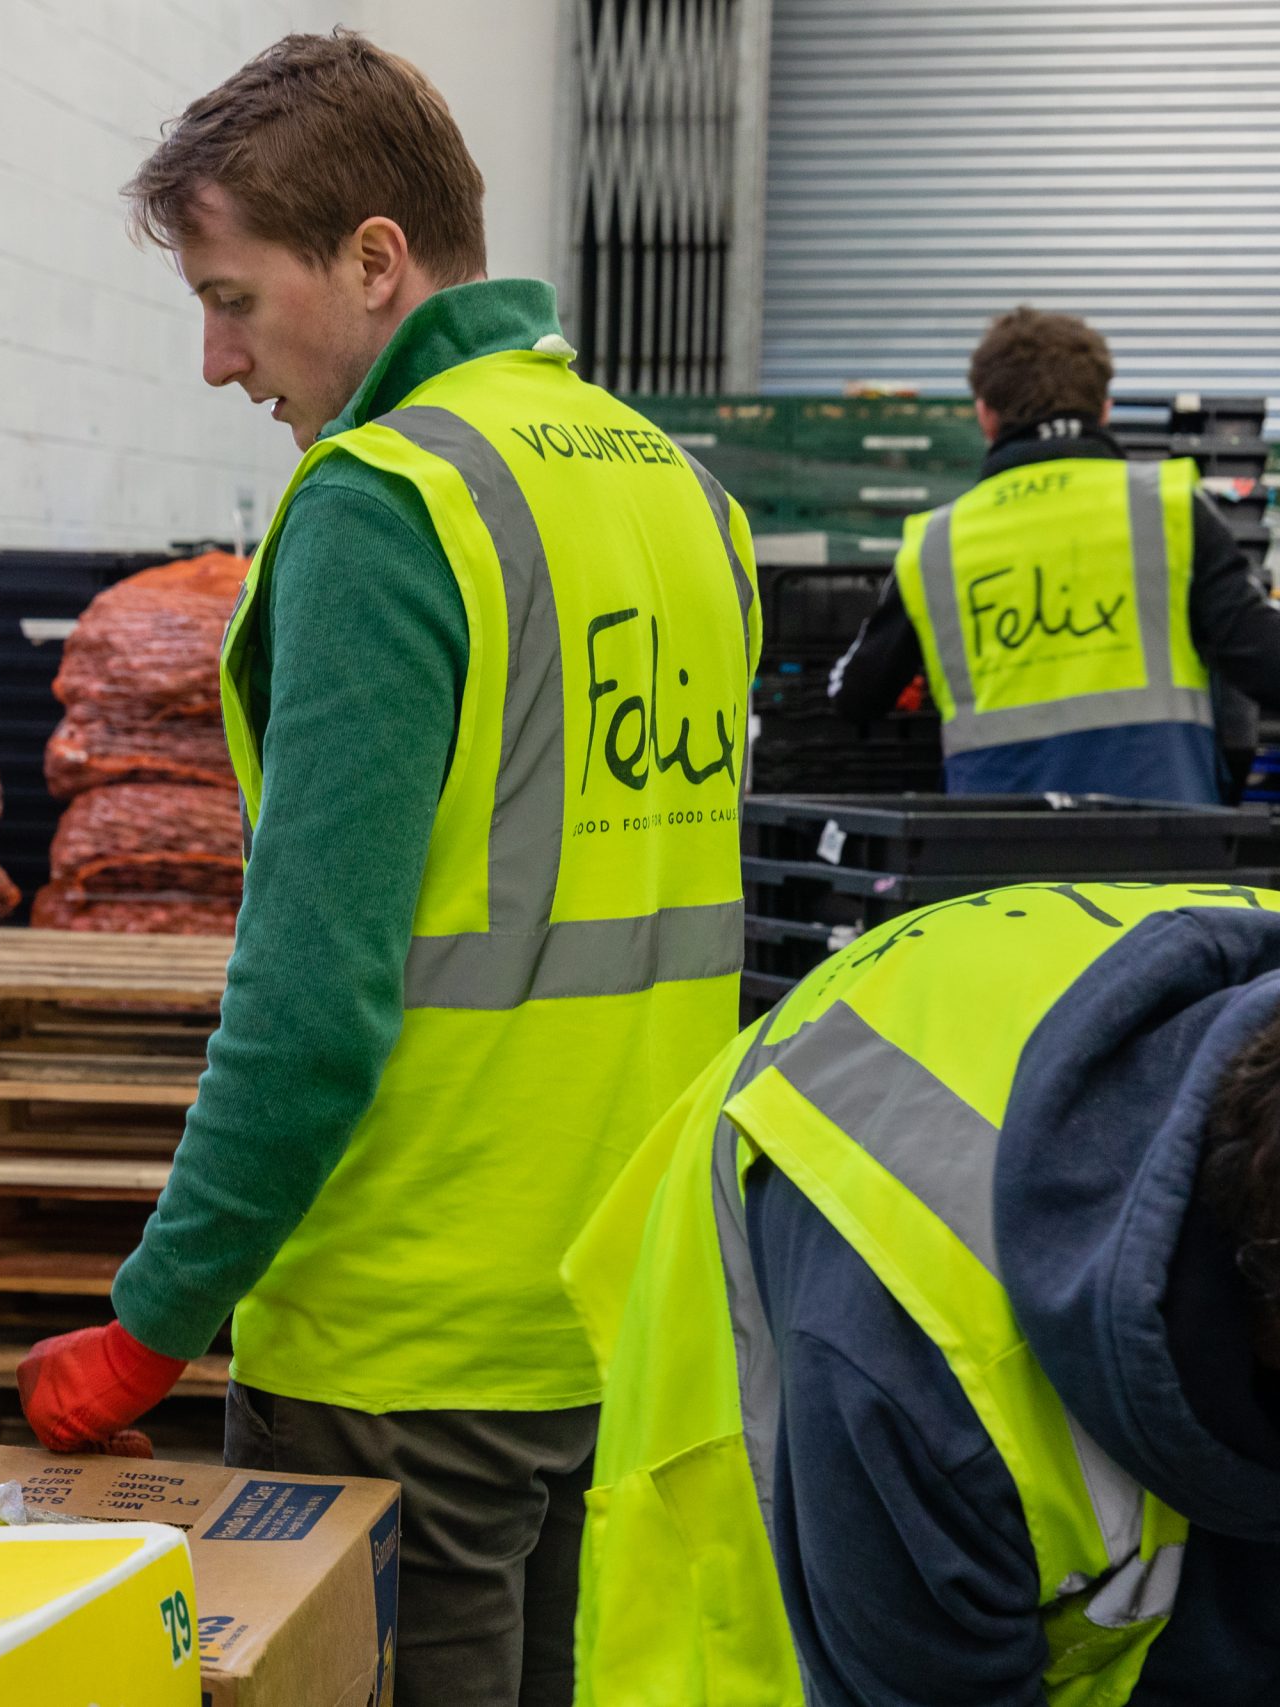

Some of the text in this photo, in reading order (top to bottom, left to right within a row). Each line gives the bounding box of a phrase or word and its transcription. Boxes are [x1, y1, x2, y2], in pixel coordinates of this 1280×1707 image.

[510, 423, 684, 468] VOLUNTEER
[994, 472, 1073, 506] STAFF
[967, 565, 1125, 657] Felix
[581, 607, 737, 797] Felix
[668, 811, 703, 825] GOOD
[711, 807, 739, 821] CAUS
[112, 1480, 166, 1493] Date:
[118, 1472, 184, 1486] Batch:
[105, 1490, 166, 1503] Code:
[172, 1497, 201, 1506] FY
[213, 1517, 251, 1538] Handle
[246, 1485, 277, 1501] Care
[160, 1590, 191, 1662] 79
